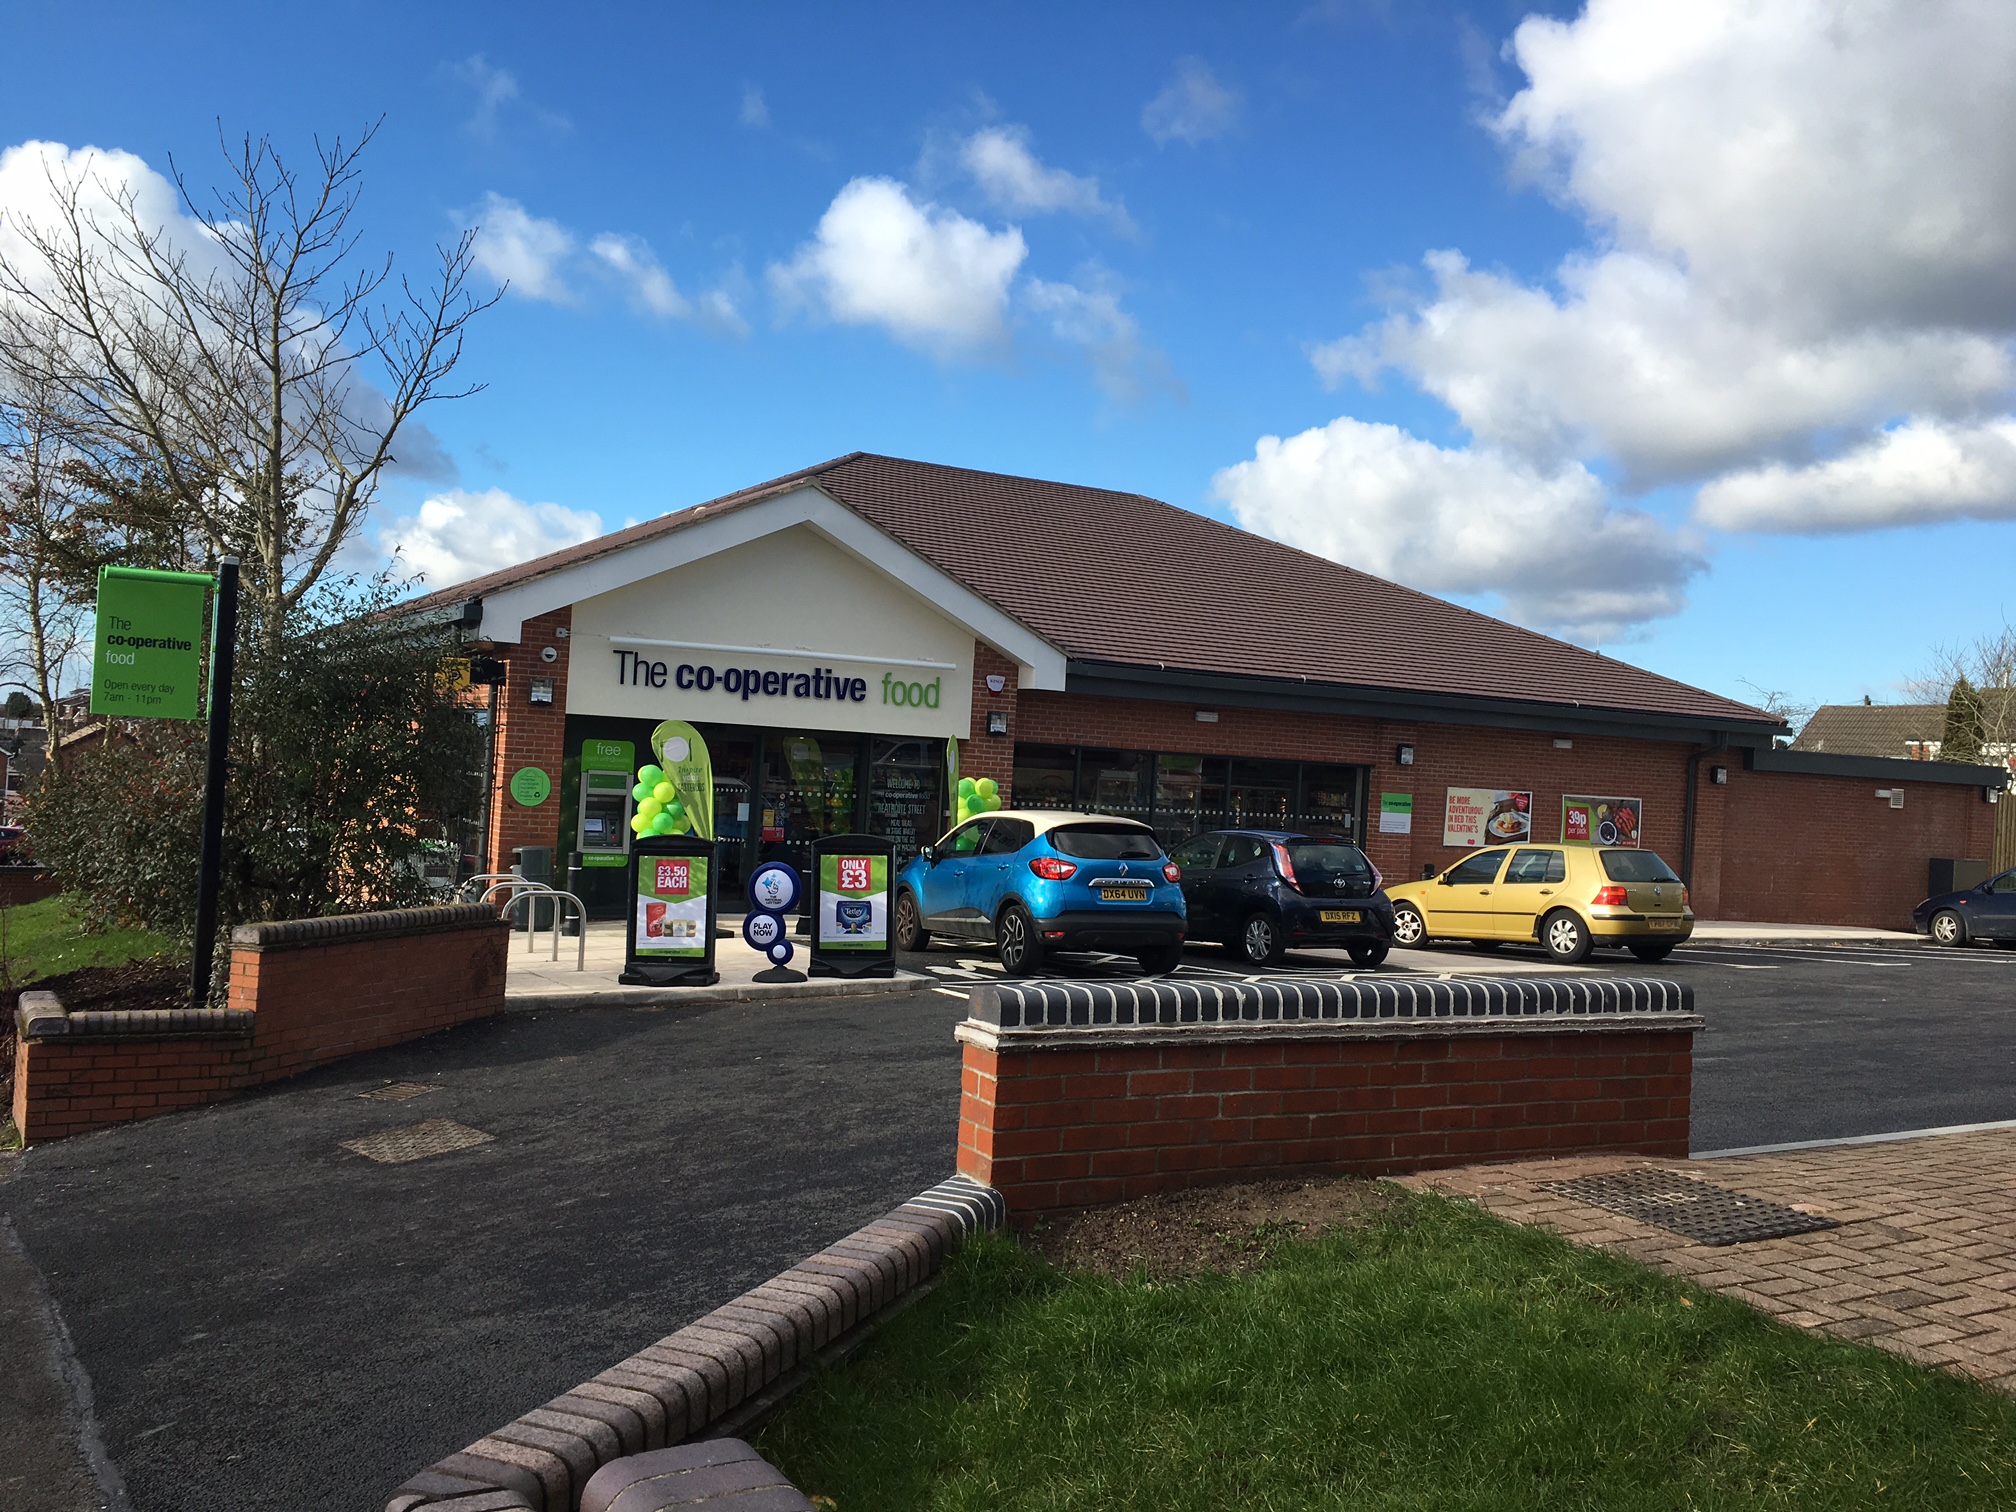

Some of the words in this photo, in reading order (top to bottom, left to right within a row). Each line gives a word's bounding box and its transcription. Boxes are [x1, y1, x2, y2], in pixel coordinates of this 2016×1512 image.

[109, 616, 131, 631] The
[107, 634, 192, 651] co-operative
[105, 650, 134, 665] food
[613, 650, 668, 689] The
[676, 663, 867, 703] co-operative
[881, 672, 941, 708] food
[104, 679, 128, 690] Open
[131, 682, 156, 693] every
[158, 683, 175, 695] day
[104, 692, 124, 702] 7am
[135, 694, 161, 705] 11pm
[596, 742, 621, 756] free
[885, 791, 918, 799] co-operative
[1457, 796, 1471, 805] MORE
[1568, 810, 1587, 828] 39p
[841, 859, 867, 870] ONLY
[658, 865, 687, 877] £3.50
[657, 876, 687, 888] EACH
[841, 869, 867, 889] £3
[1103, 889, 1126, 898] DX64
[1128, 889, 1145, 899] UVN
[844, 907, 862, 916] Tetley
[1325, 912, 1342, 920] DX15
[1342, 912, 1356, 920] RFZ
[753, 922, 773, 930] PLAY
